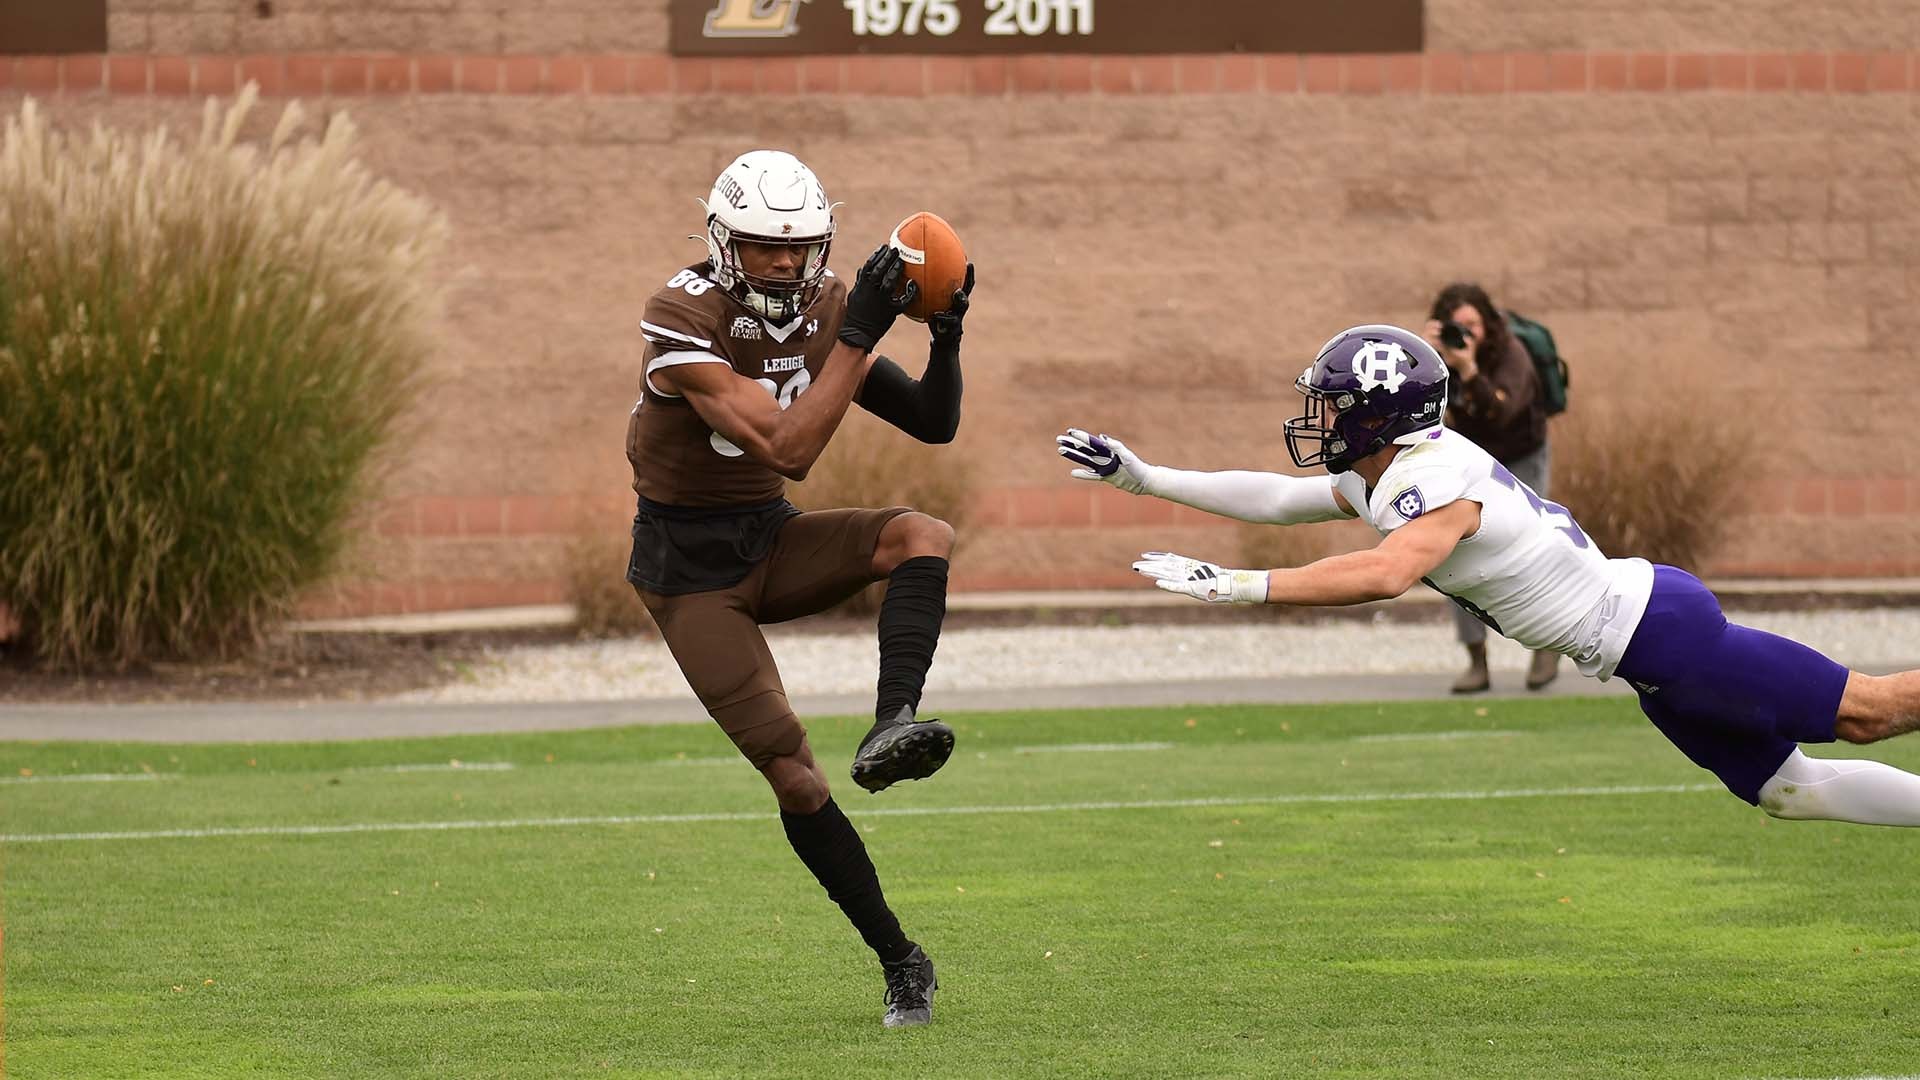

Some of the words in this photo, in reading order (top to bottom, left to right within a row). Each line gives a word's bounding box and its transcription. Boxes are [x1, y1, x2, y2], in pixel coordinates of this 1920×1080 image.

[844, 0, 961, 36] 1975
[983, 0, 1094, 36] 2011
[714, 173, 744, 209] HIGH
[667, 269, 715, 296] 88
[763, 355, 805, 372] LEHIGH
[1423, 402, 1437, 414] BM
